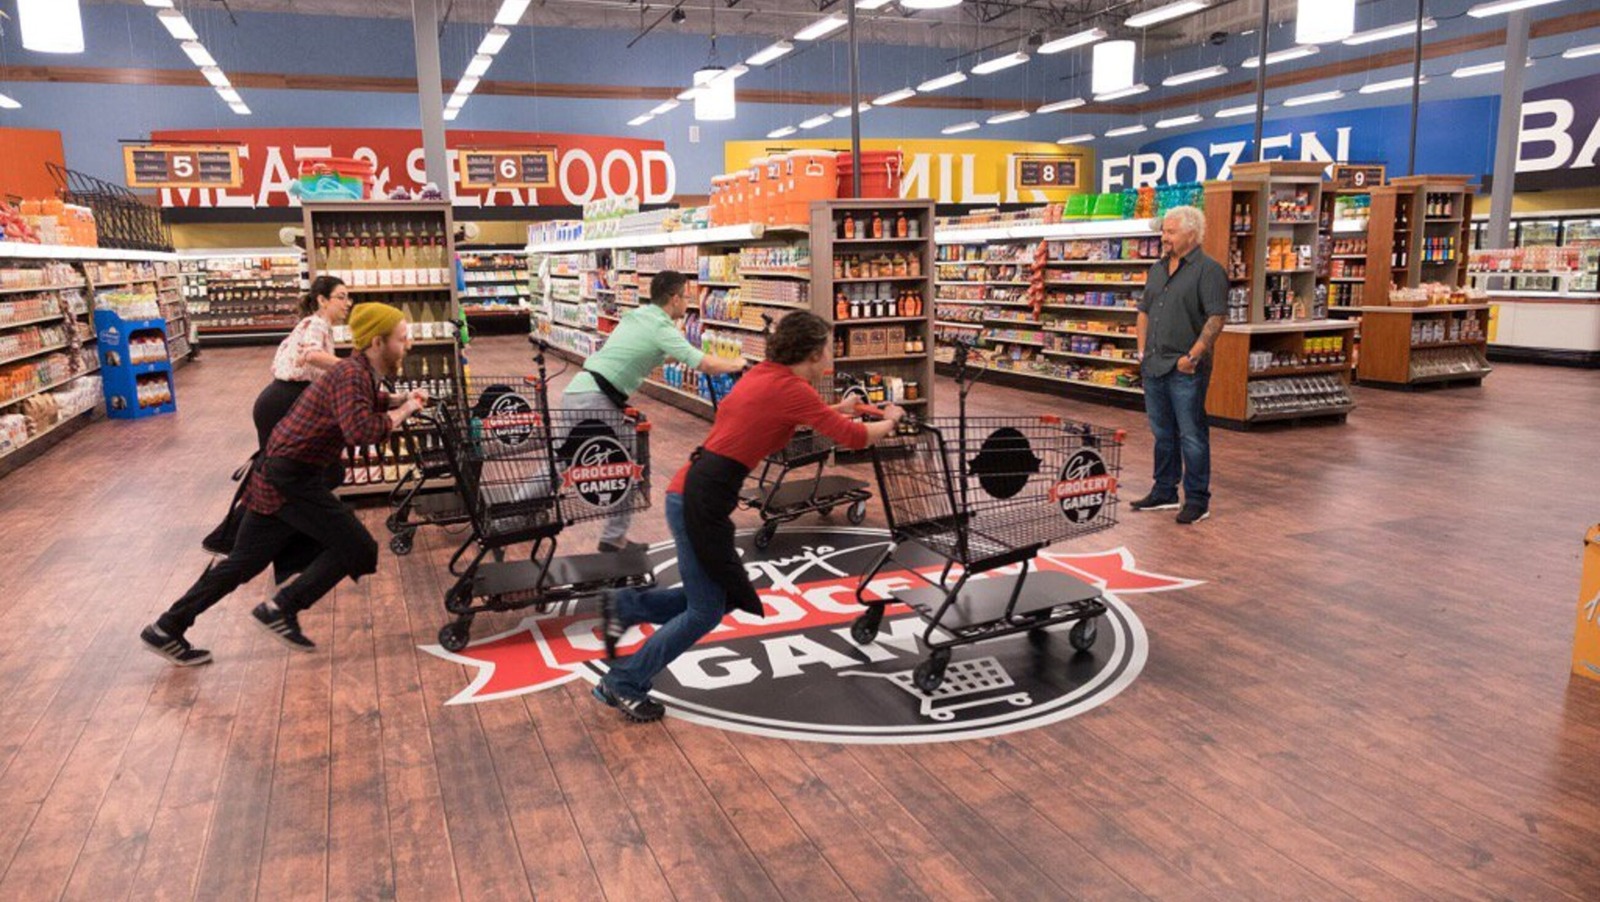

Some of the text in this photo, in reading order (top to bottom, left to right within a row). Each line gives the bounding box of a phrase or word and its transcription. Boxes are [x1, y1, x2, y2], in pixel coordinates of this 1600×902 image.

[173, 155, 194, 177] 5
[500, 159, 517, 178] 6
[1043, 164, 1055, 181] 8
[406, 147, 677, 208] SEOOD
[1354, 171, 1365, 186] 9
[572, 464, 632, 480] GROCERY
[580, 479, 626, 493] GAMES
[1057, 476, 1109, 496] GROCERY
[1062, 493, 1103, 510] GAMES
[666, 617, 968, 690] GAM
